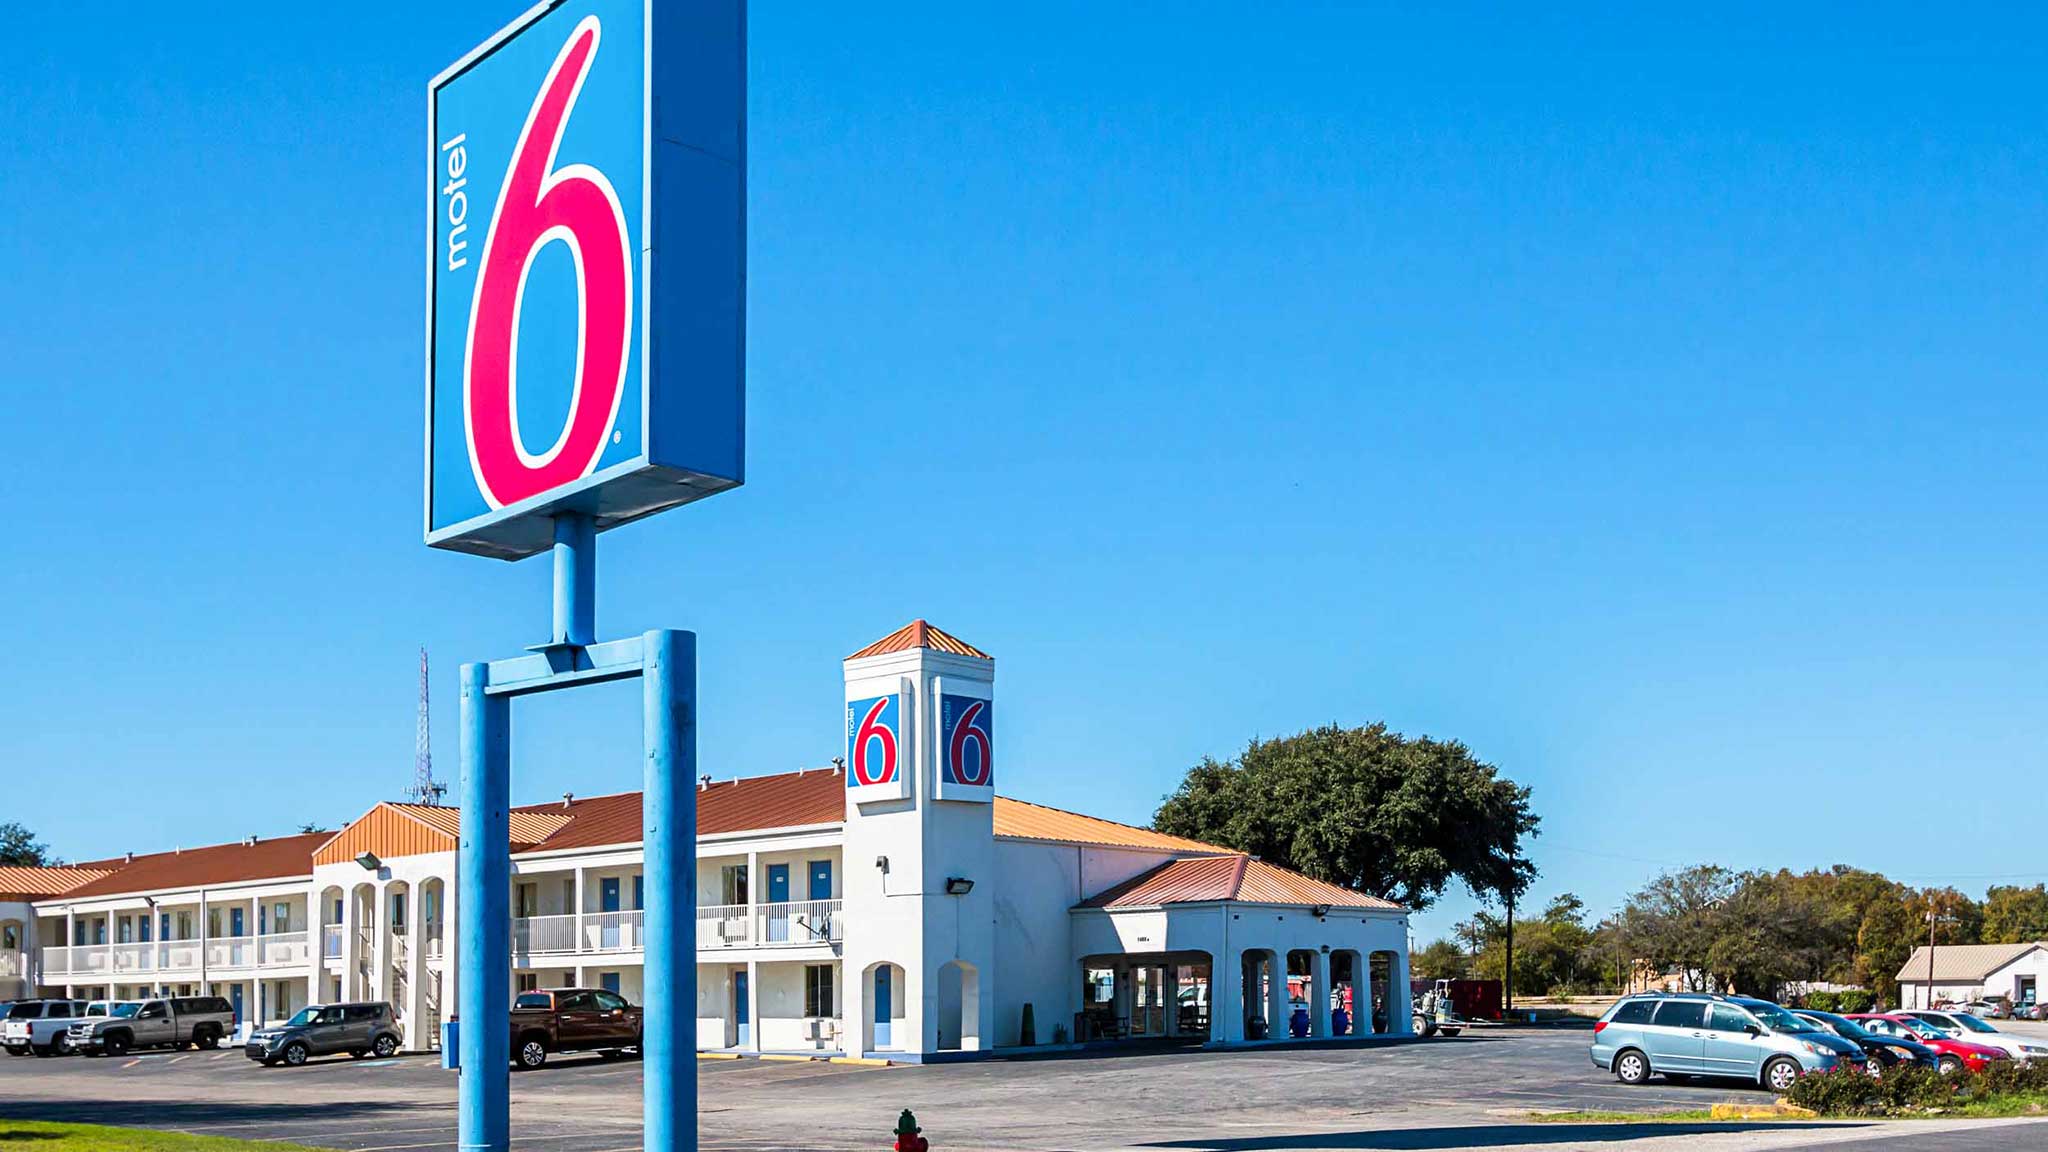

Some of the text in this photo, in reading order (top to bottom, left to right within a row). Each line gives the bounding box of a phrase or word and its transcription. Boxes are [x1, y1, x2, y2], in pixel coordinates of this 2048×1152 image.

[442, 132, 467, 271] motel
[463, 14, 633, 510] 6
[853, 697, 898, 786] 6
[950, 701, 991, 786] 6
